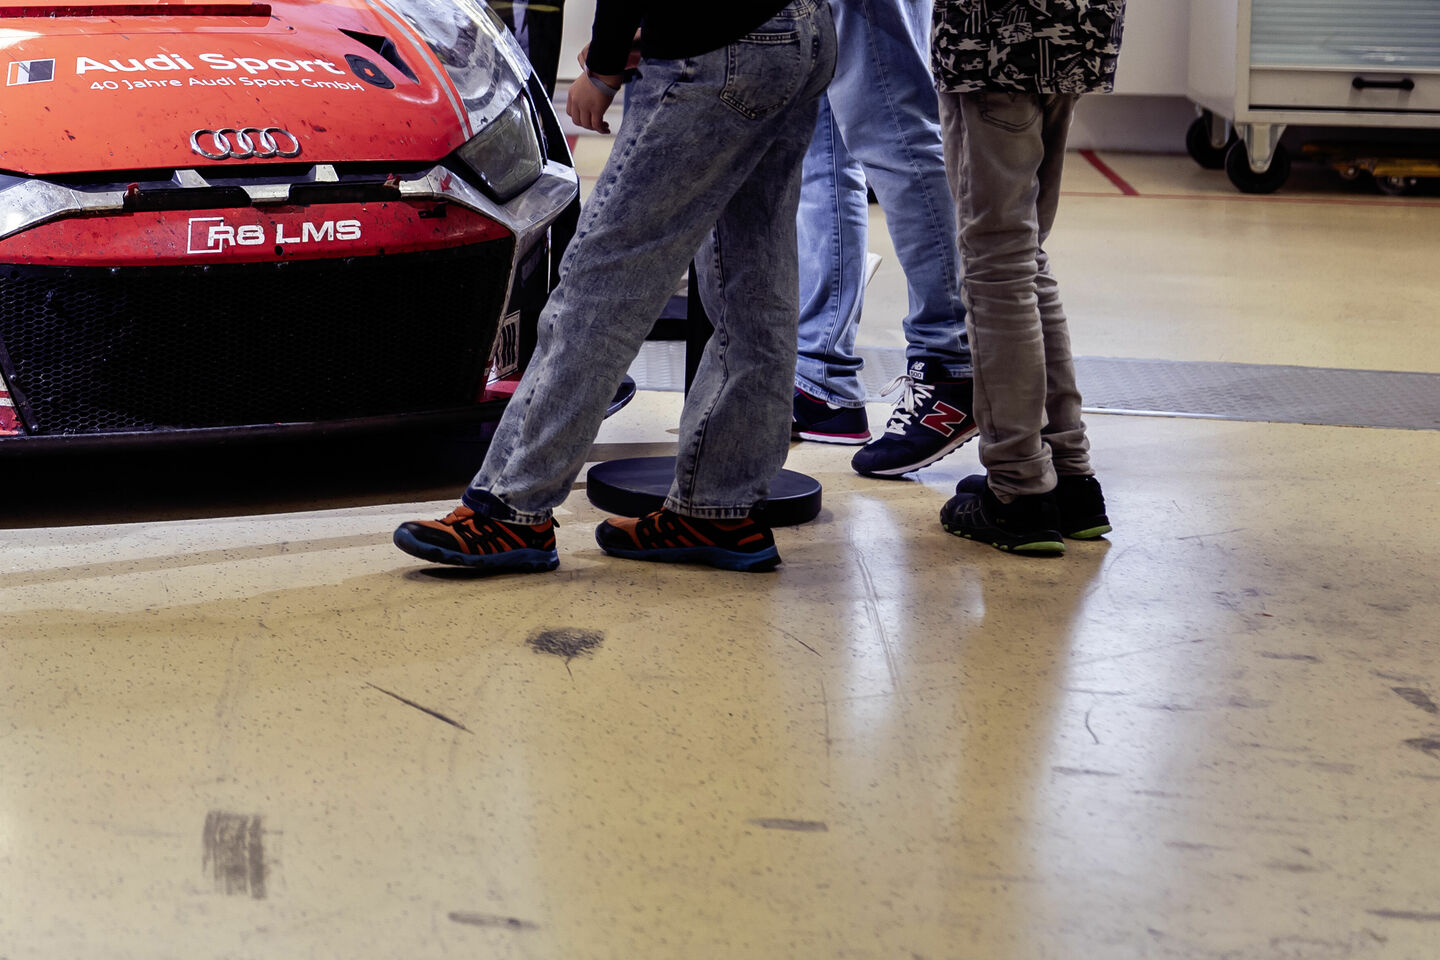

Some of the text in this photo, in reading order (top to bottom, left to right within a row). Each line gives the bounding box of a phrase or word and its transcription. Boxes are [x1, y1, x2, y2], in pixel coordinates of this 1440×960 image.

[75, 53, 346, 75] Audi Sport
[90, 77, 366, 92] 40 Jahre Audi Sport GmbH
[207, 219, 362, 247] R8 LMS
[920, 400, 967, 437] N
